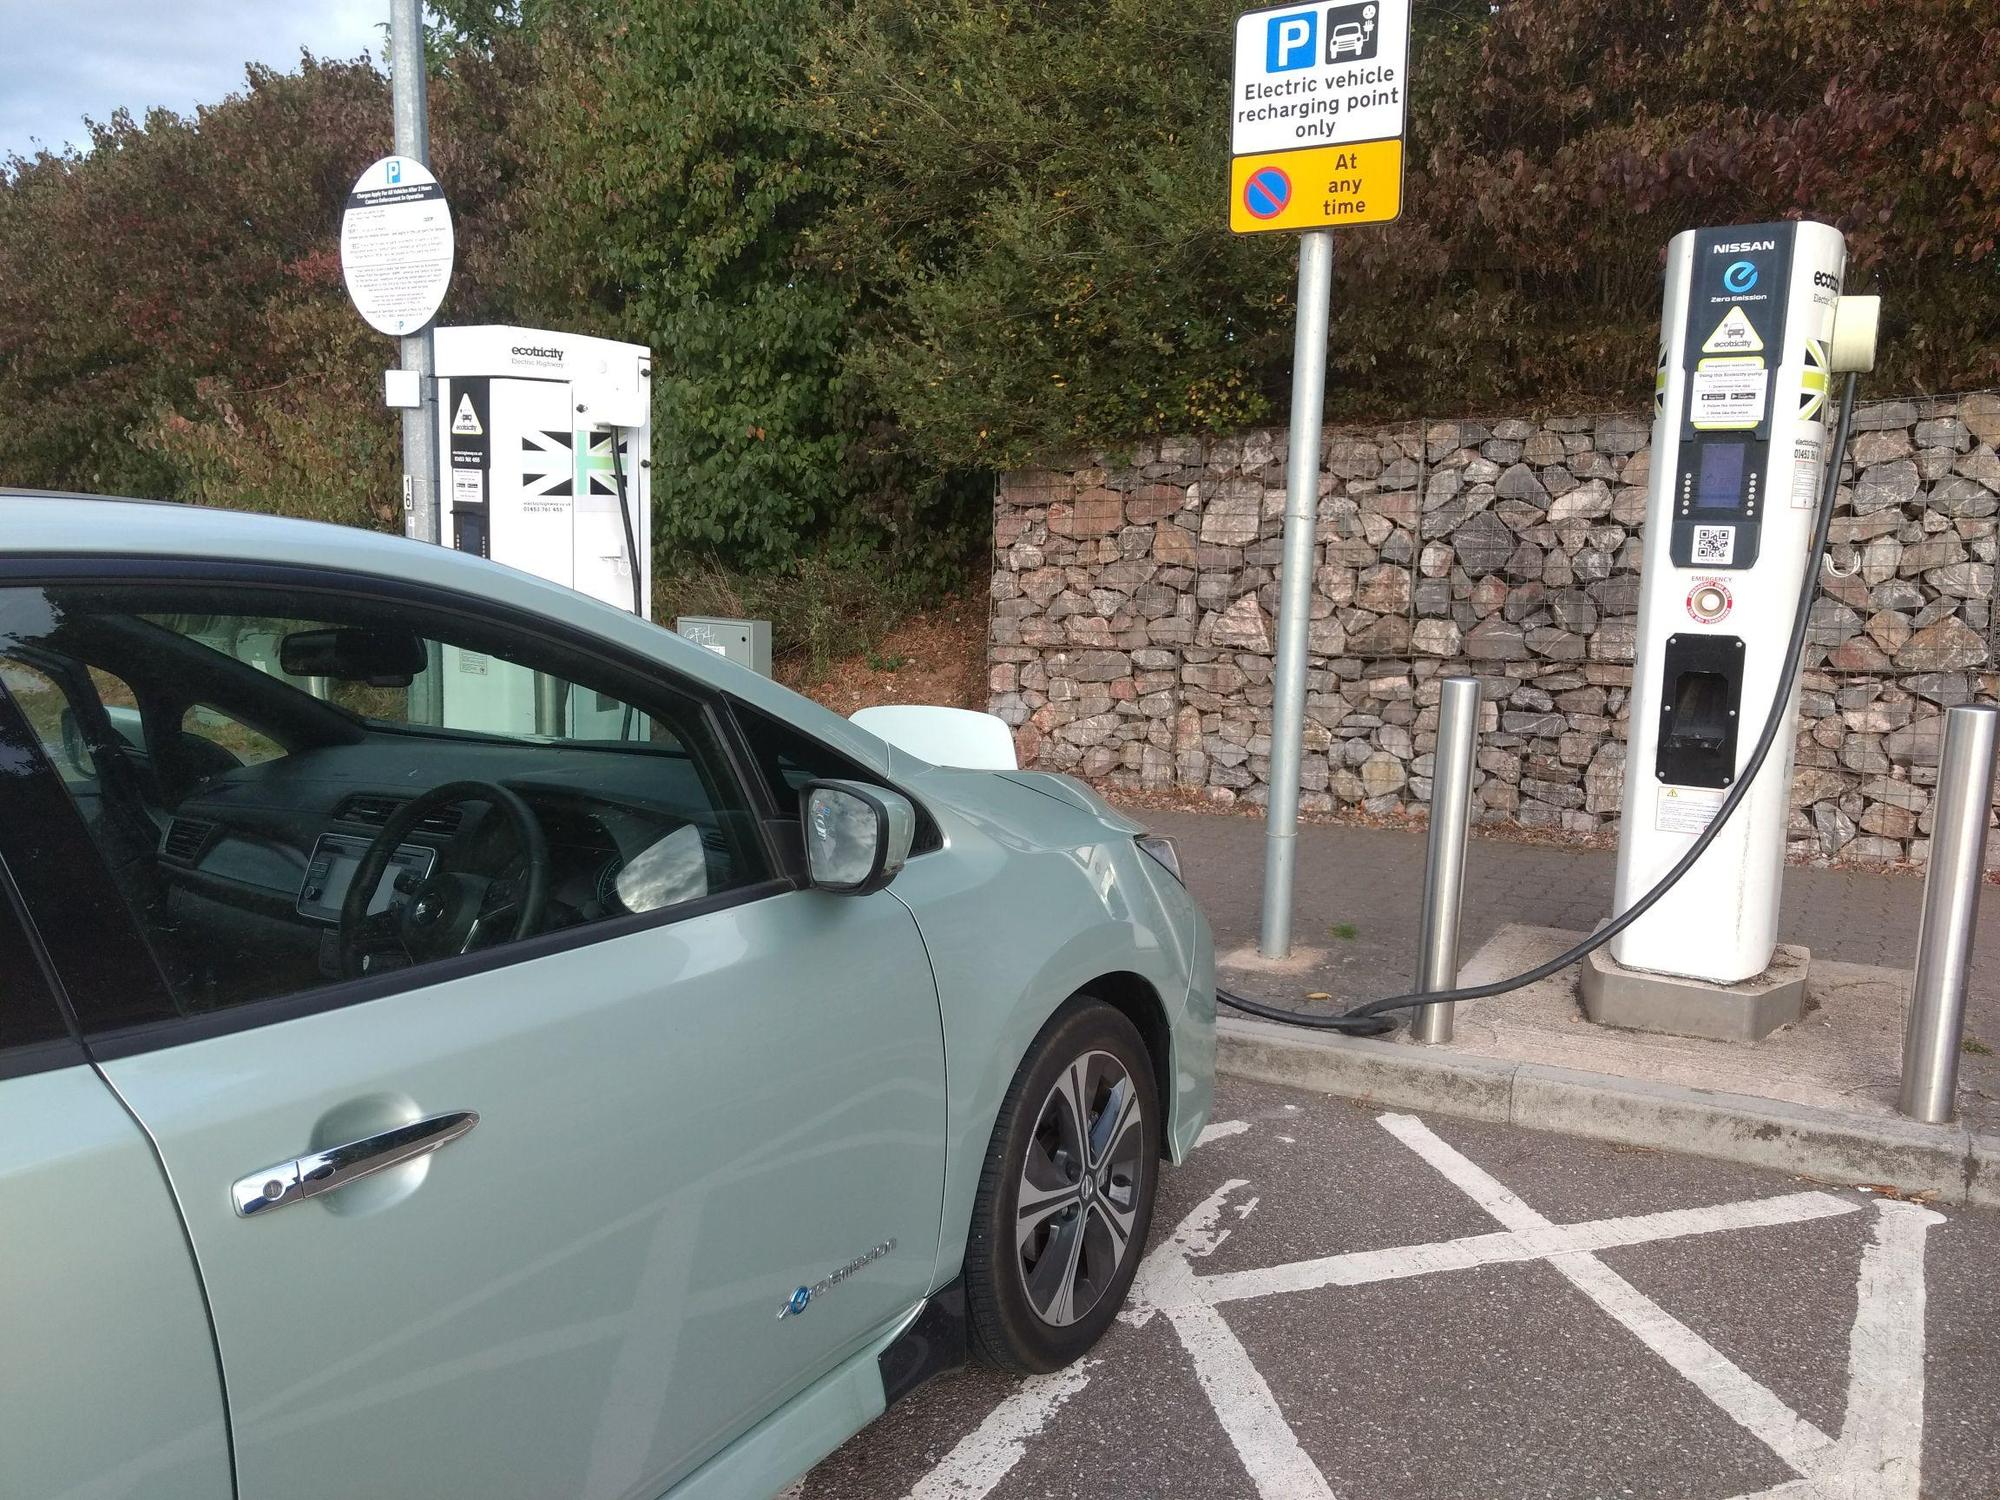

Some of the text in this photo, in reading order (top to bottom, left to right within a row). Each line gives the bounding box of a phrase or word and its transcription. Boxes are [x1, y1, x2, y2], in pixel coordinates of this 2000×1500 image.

[1278, 19, 1310, 67] P
[1245, 66, 1394, 100] Electric vehicle
[1238, 87, 1399, 122] recharging point
[1295, 119, 1335, 137] only
[1335, 153, 1357, 171] At
[387, 162, 399, 184] P
[1328, 178, 1362, 195] any
[1323, 199, 1366, 216] time
[1713, 240, 1775, 254] NISSAN
[1731, 294, 1767, 302] Emission
[1714, 339, 1752, 348] ecotricity
[512, 346, 564, 361] ecotricity
